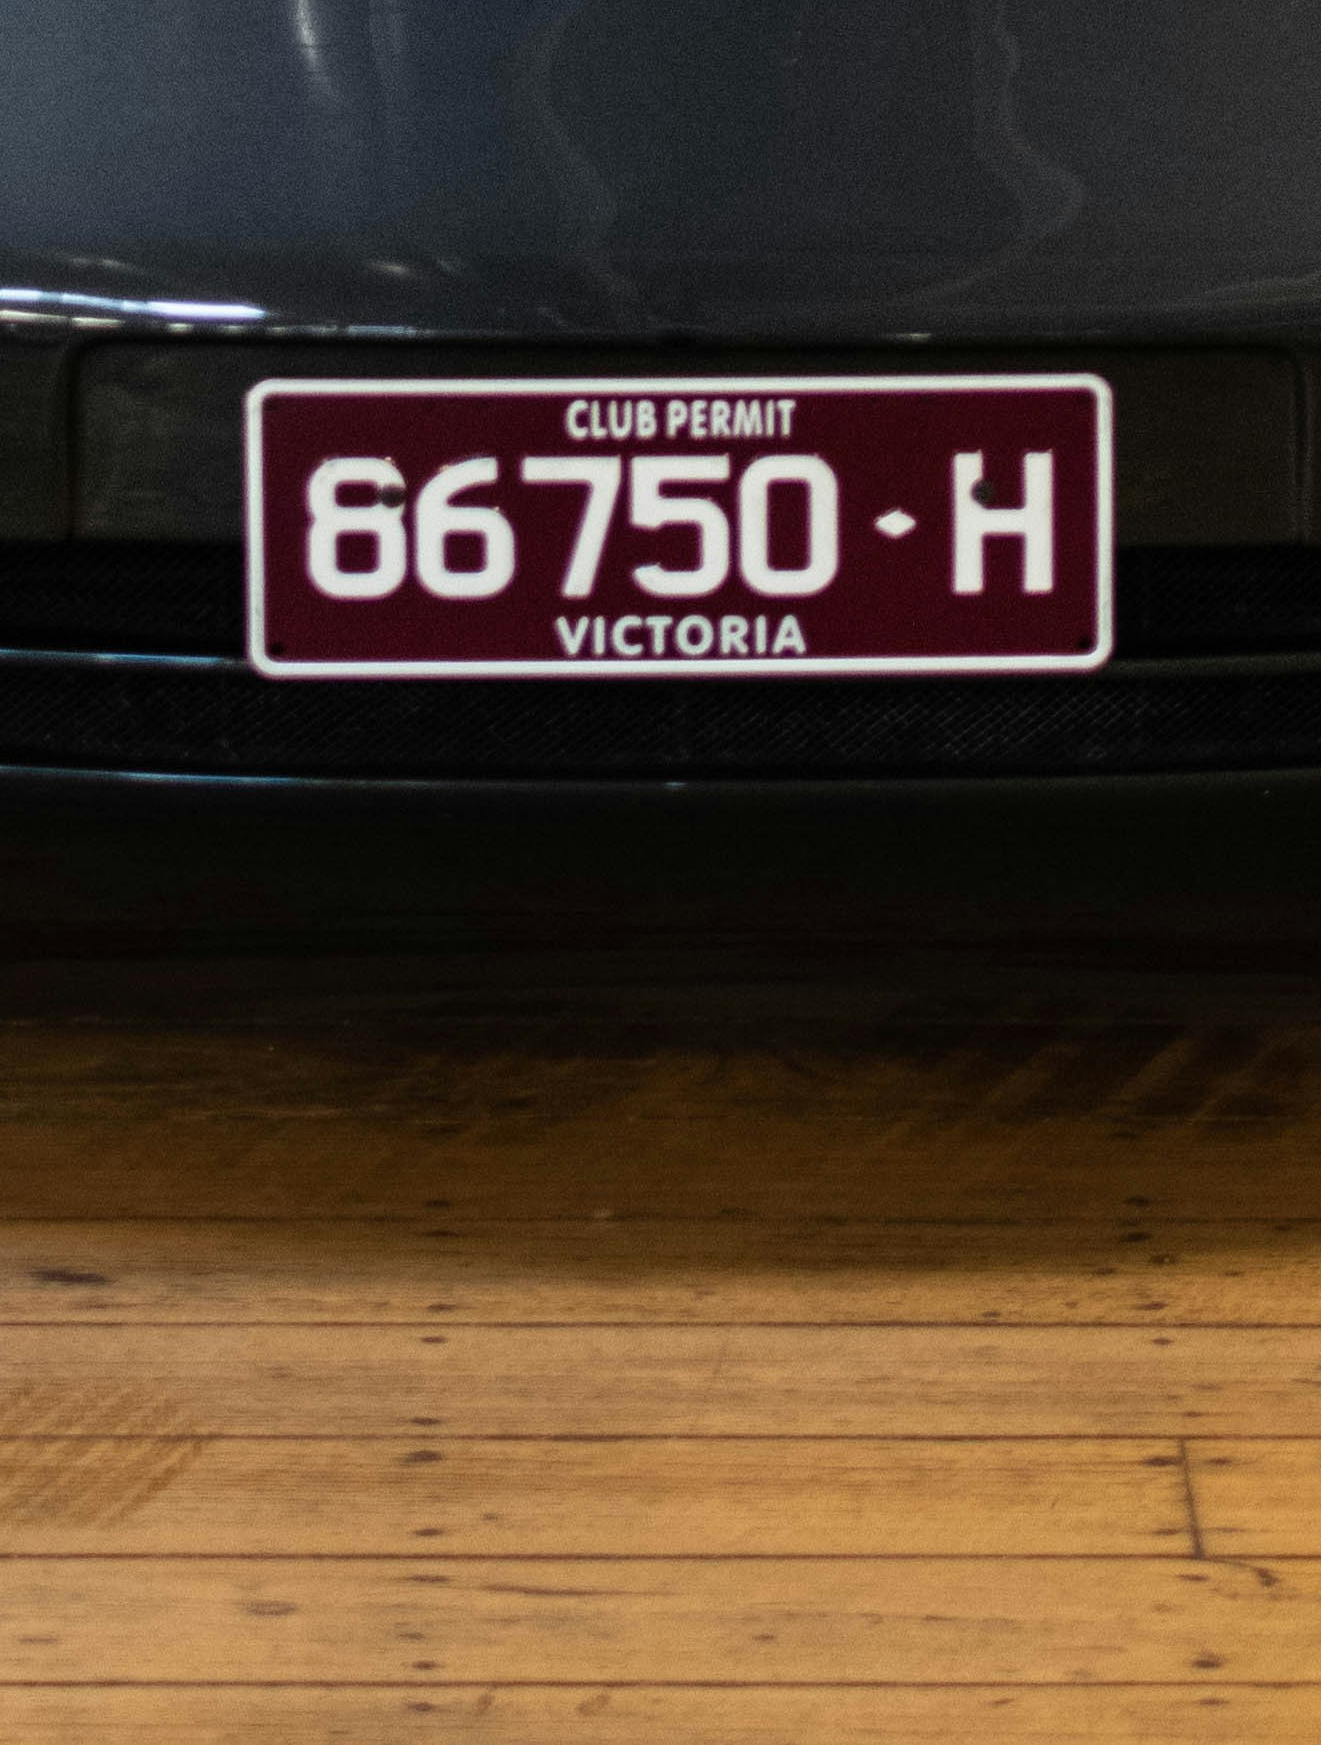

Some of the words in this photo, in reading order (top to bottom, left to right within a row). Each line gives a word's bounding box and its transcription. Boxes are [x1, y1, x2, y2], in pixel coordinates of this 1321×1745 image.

[566, 399, 657, 440] CLUB
[666, 399, 797, 438] PERMIT
[306, 454, 839, 600] 86750
[952, 451, 1054, 595] H
[556, 614, 807, 656] VICTORIA
